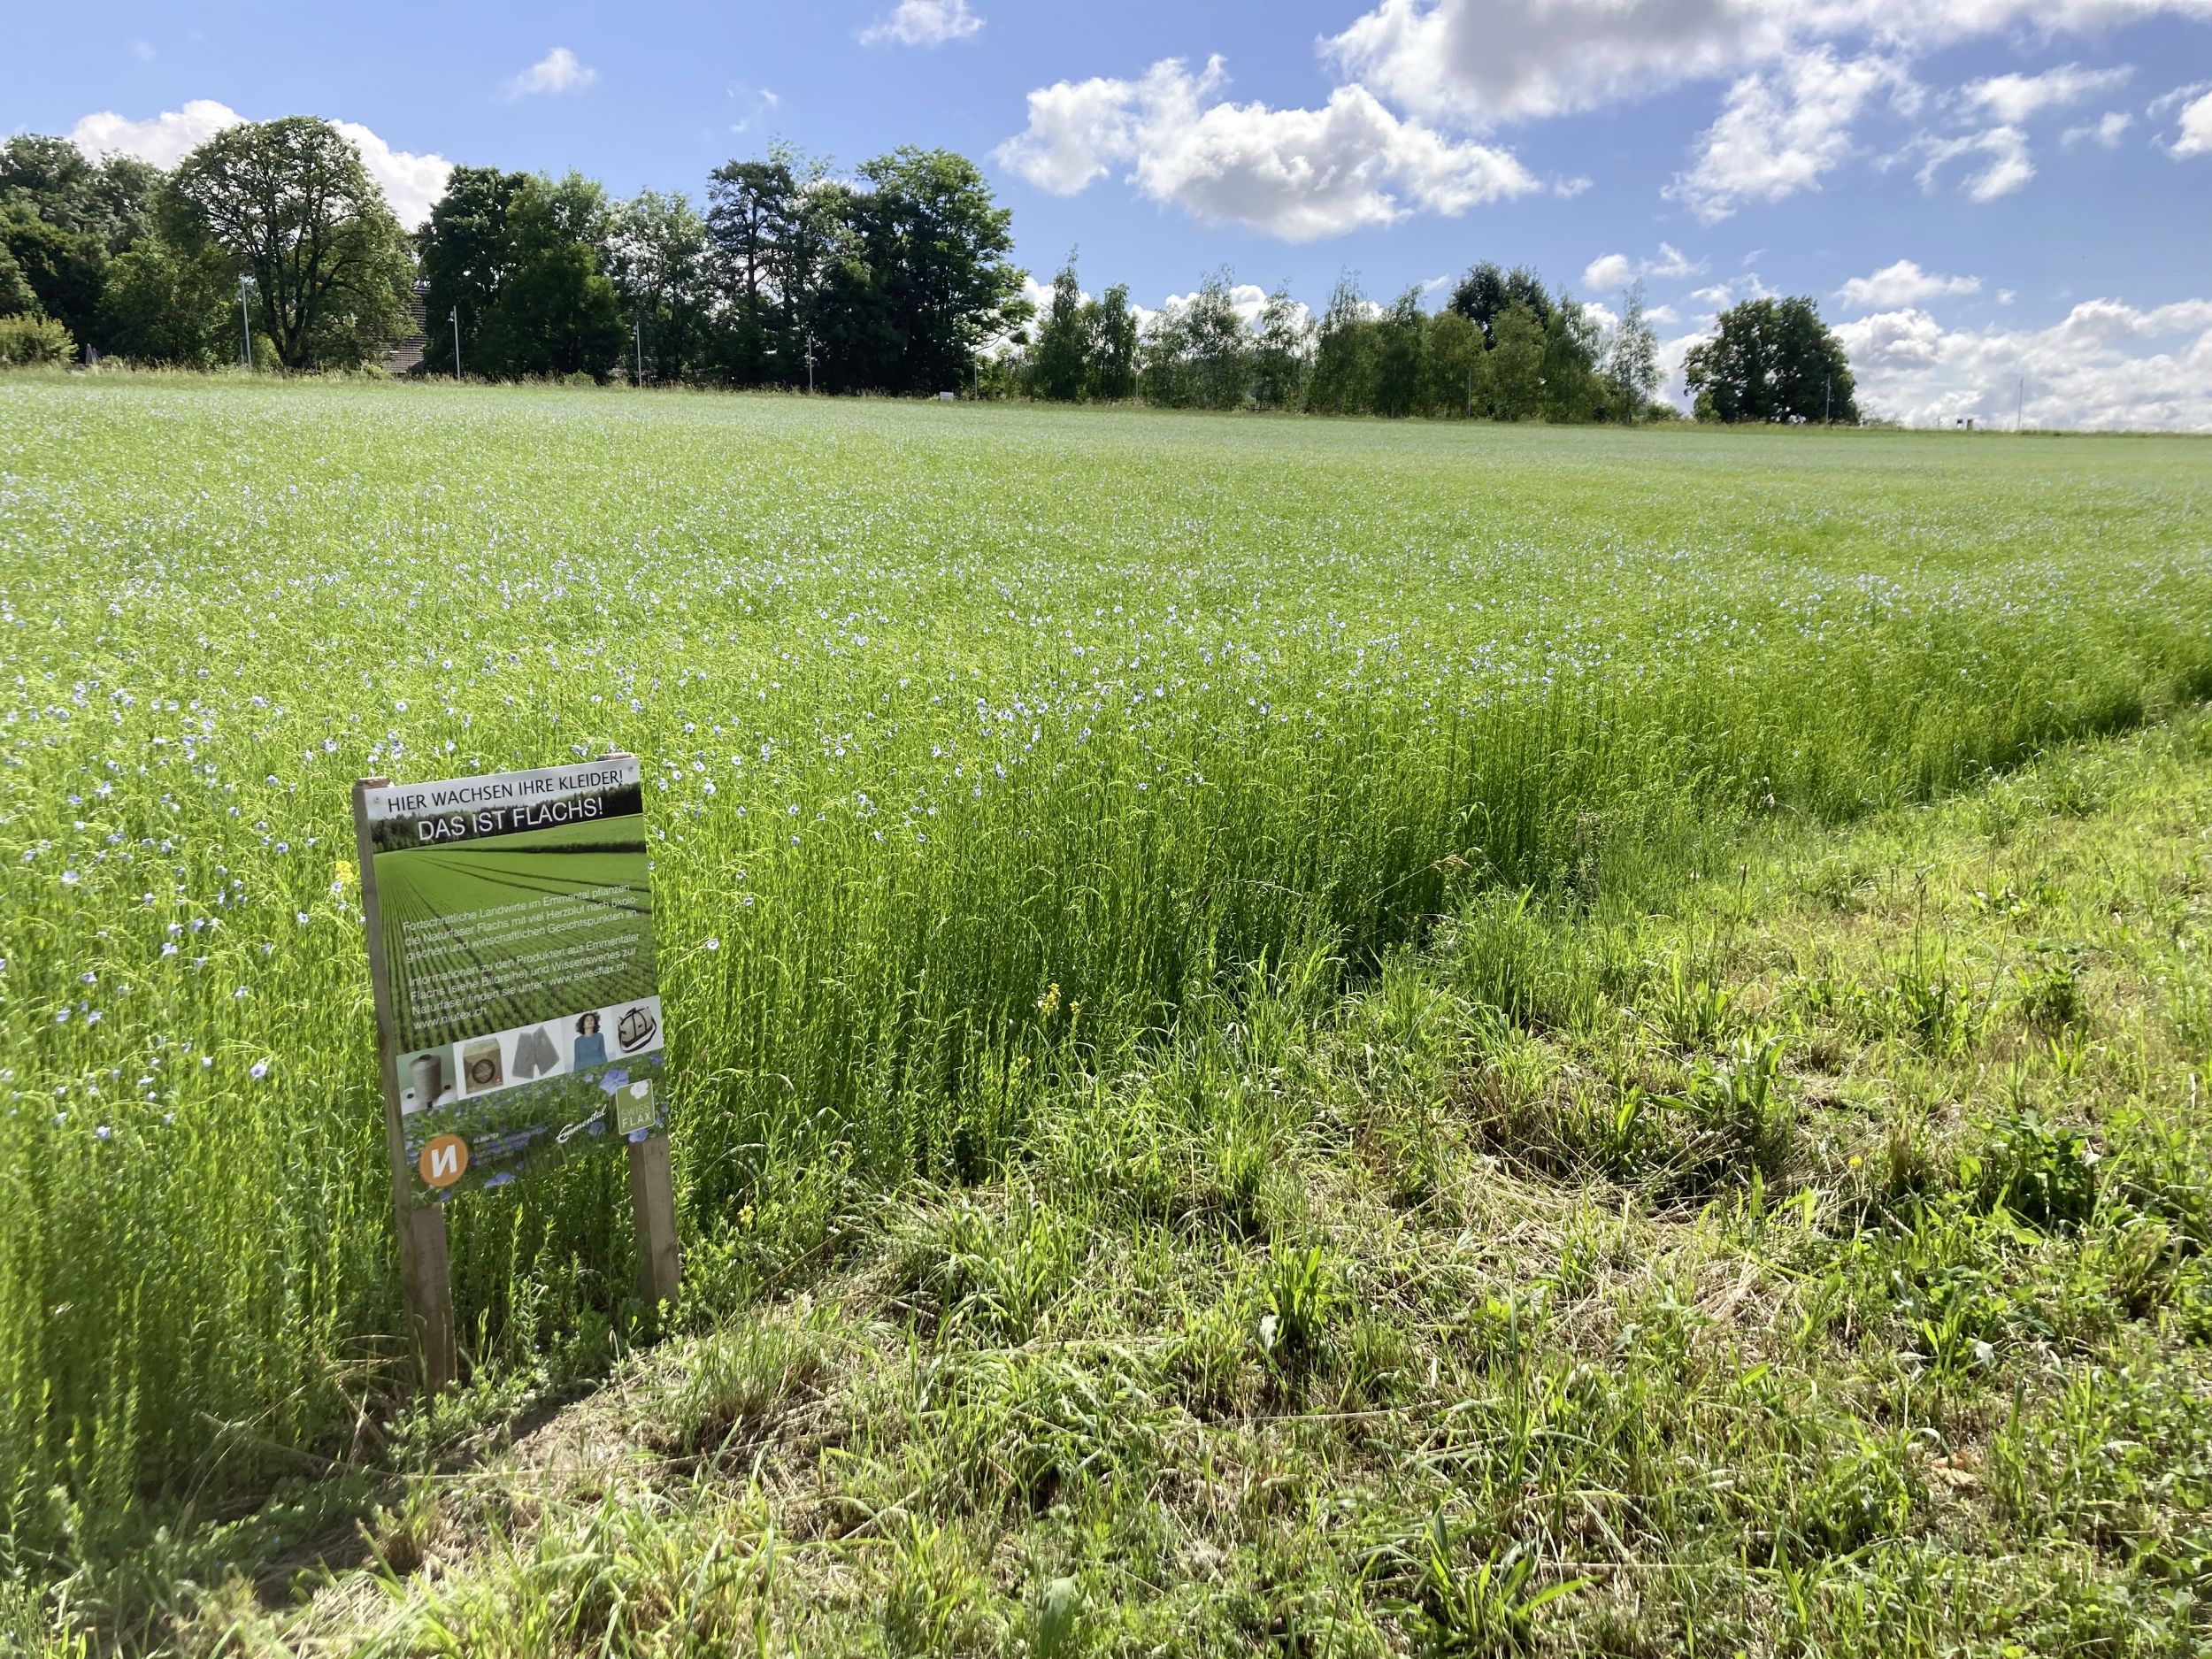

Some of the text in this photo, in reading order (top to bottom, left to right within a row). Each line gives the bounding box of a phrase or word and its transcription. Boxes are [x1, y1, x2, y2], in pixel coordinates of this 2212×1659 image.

[388, 770, 623, 812] HIER WACHSEN IHRE KLEIDER!
[418, 796, 603, 841] DAS IST FLACHS!
[403, 884, 630, 932] Fortschrittliche Landwirte im Emmental pflanzen
[404, 895, 639, 947] die Naturfaser Flachs mit viel Herzblut nach ökolo-
[406, 945, 447, 963] gischen
[449, 941, 468, 953] und
[472, 926, 545, 948] wirtschaftlichen
[548, 911, 624, 933] Gesichtspunkten
[409, 933, 640, 987] Informationen zu den Produkten aus Emmentaler
[410, 947, 637, 1001] Flachs (siehe Bildreihe) und Wissenswertes zur
[412, 996, 465, 1016] Naturfaser
[468, 989, 500, 1004] finden
[502, 986, 516, 997] sie
[413, 1006, 488, 1030] www.niutex.ch
[621, 1102, 650, 1117] SWISS
[622, 1111, 652, 1129] FLAX
